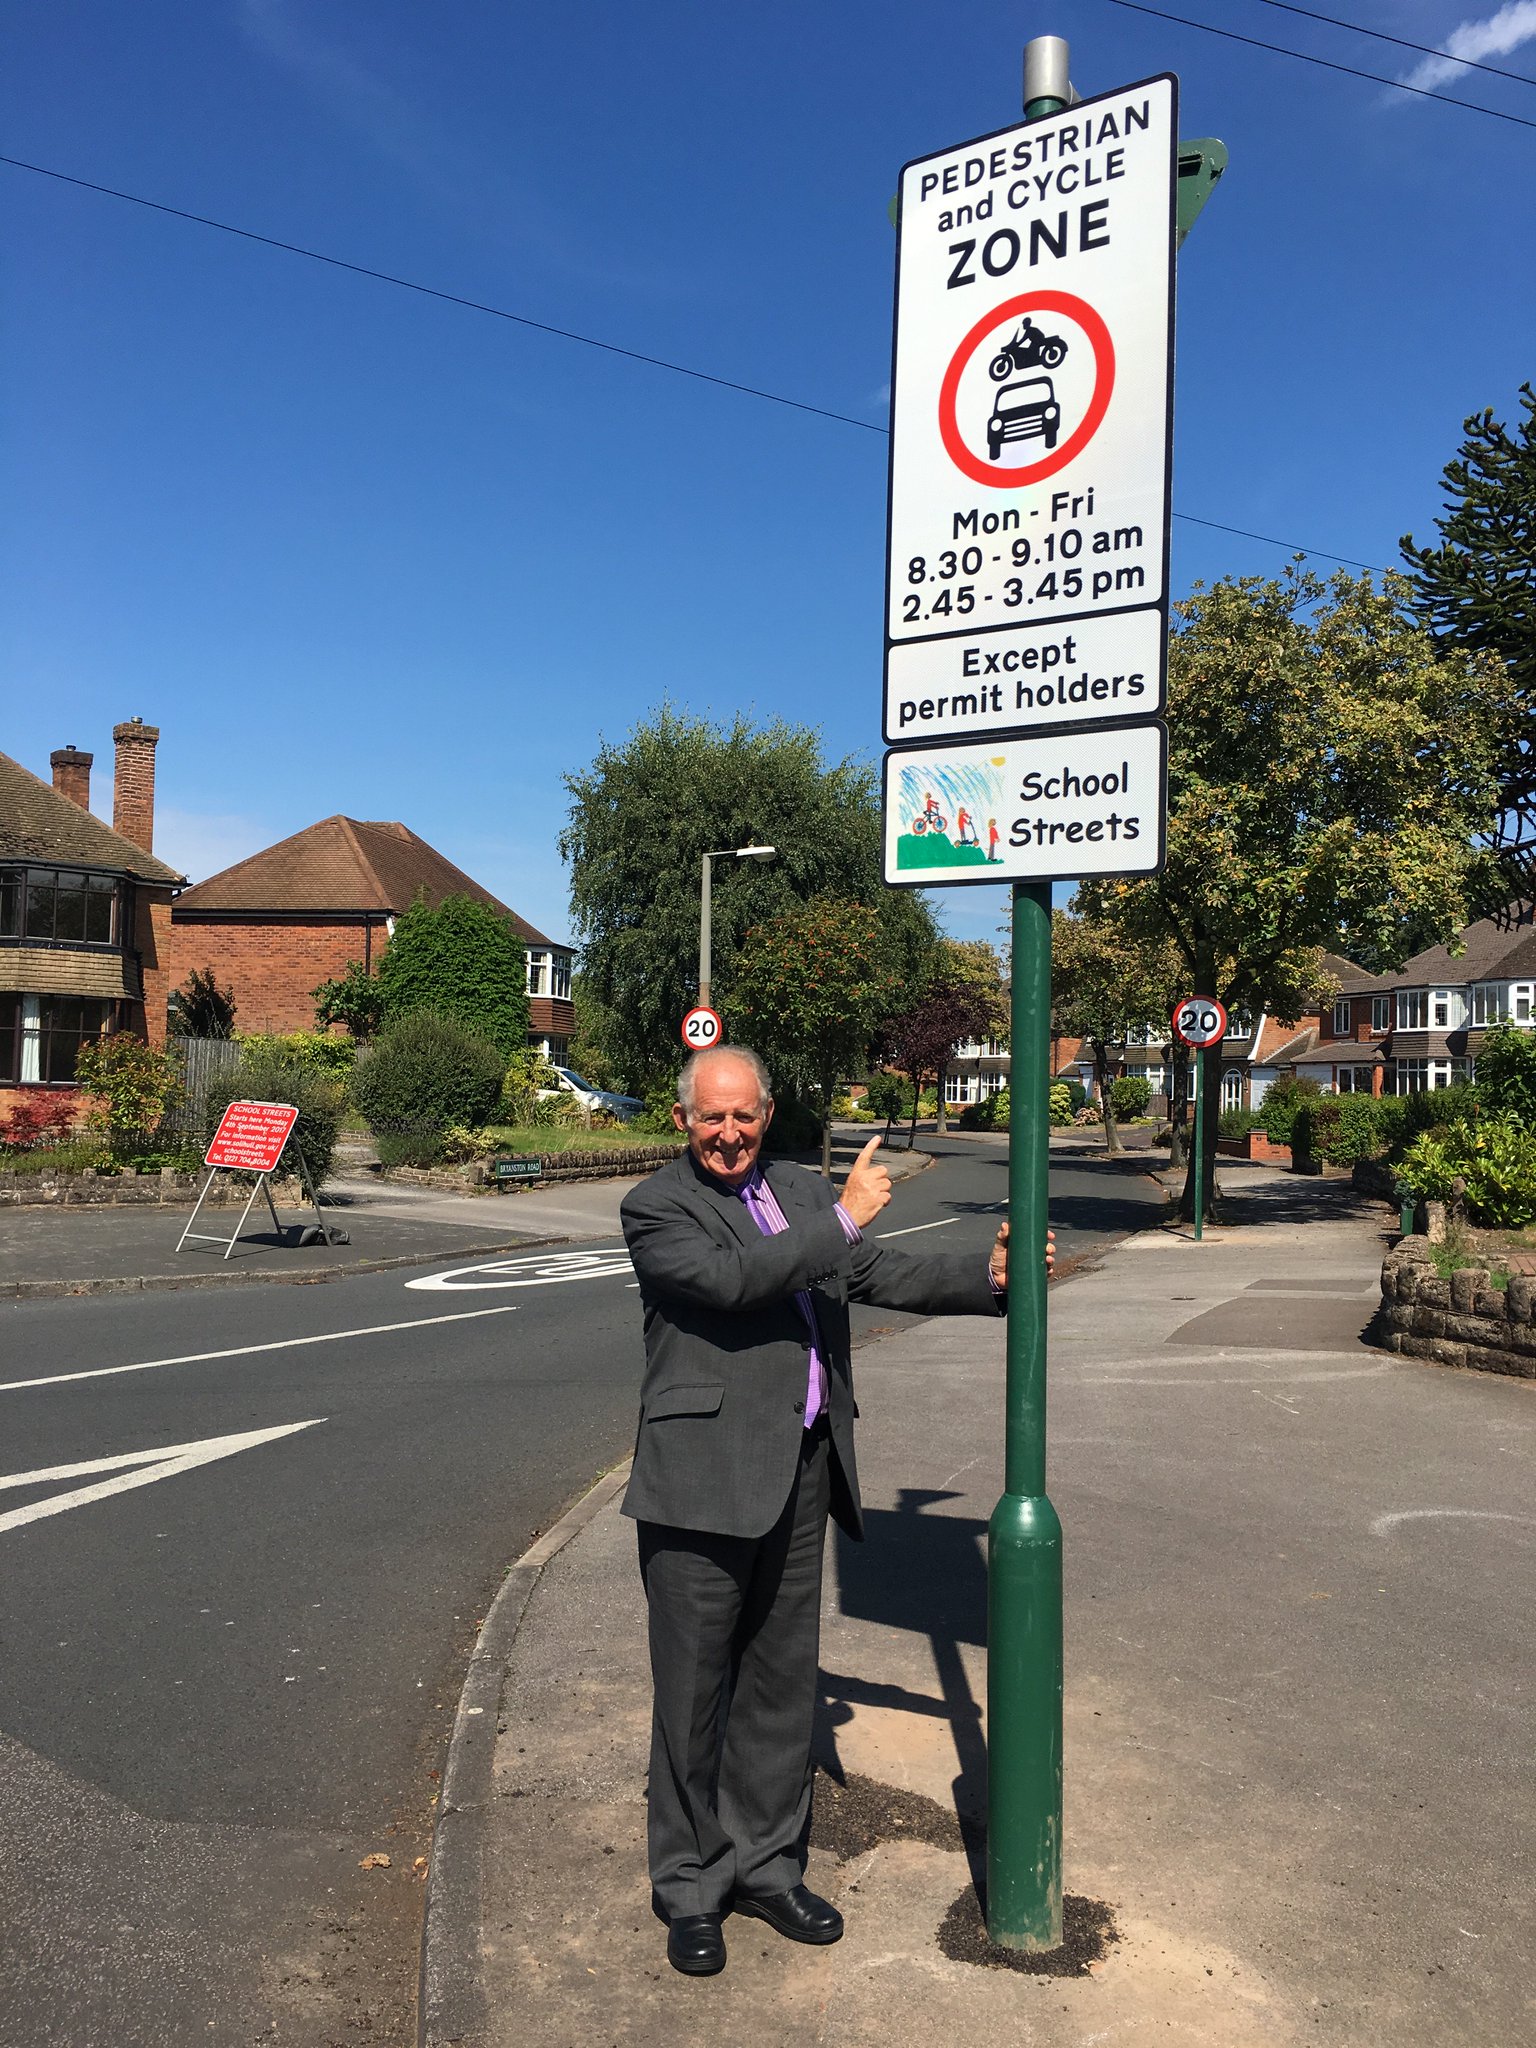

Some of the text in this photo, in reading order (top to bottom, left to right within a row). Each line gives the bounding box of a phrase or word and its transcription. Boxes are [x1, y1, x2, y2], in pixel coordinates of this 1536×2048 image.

[920, 100, 1150, 202] PEDESTRIAN
[938, 148, 1125, 232] and CYCLE
[947, 198, 1110, 290] ZONE
[952, 507, 1020, 540] Mon
[1052, 487, 1094, 522] Fri
[908, 546, 982, 585] 8.30
[1011, 528, 1083, 567] 9.10
[1092, 525, 1143, 554] am
[902, 585, 975, 623] 2.45
[1003, 568, 1082, 607] 3.45
[1092, 565, 1144, 599] pm
[962, 635, 1076, 677] Except
[899, 673, 1145, 728] permit holders
[1020, 761, 1128, 802] School
[1009, 813, 1140, 847] Streets
[688, 1019, 715, 1037] 20
[1181, 1010, 1217, 1032] 20
[233, 1106, 291, 1117] SCHOOL STREETS
[237, 1122, 270, 1132] September
[264, 1118, 288, 1126] Monday
[217, 1140, 279, 1151] www.solihull.gov.uk/
[223, 1147, 265, 1157] schoolstreets
[232, 1132, 267, 1141] information
[224, 1154, 238, 1162] 0121
